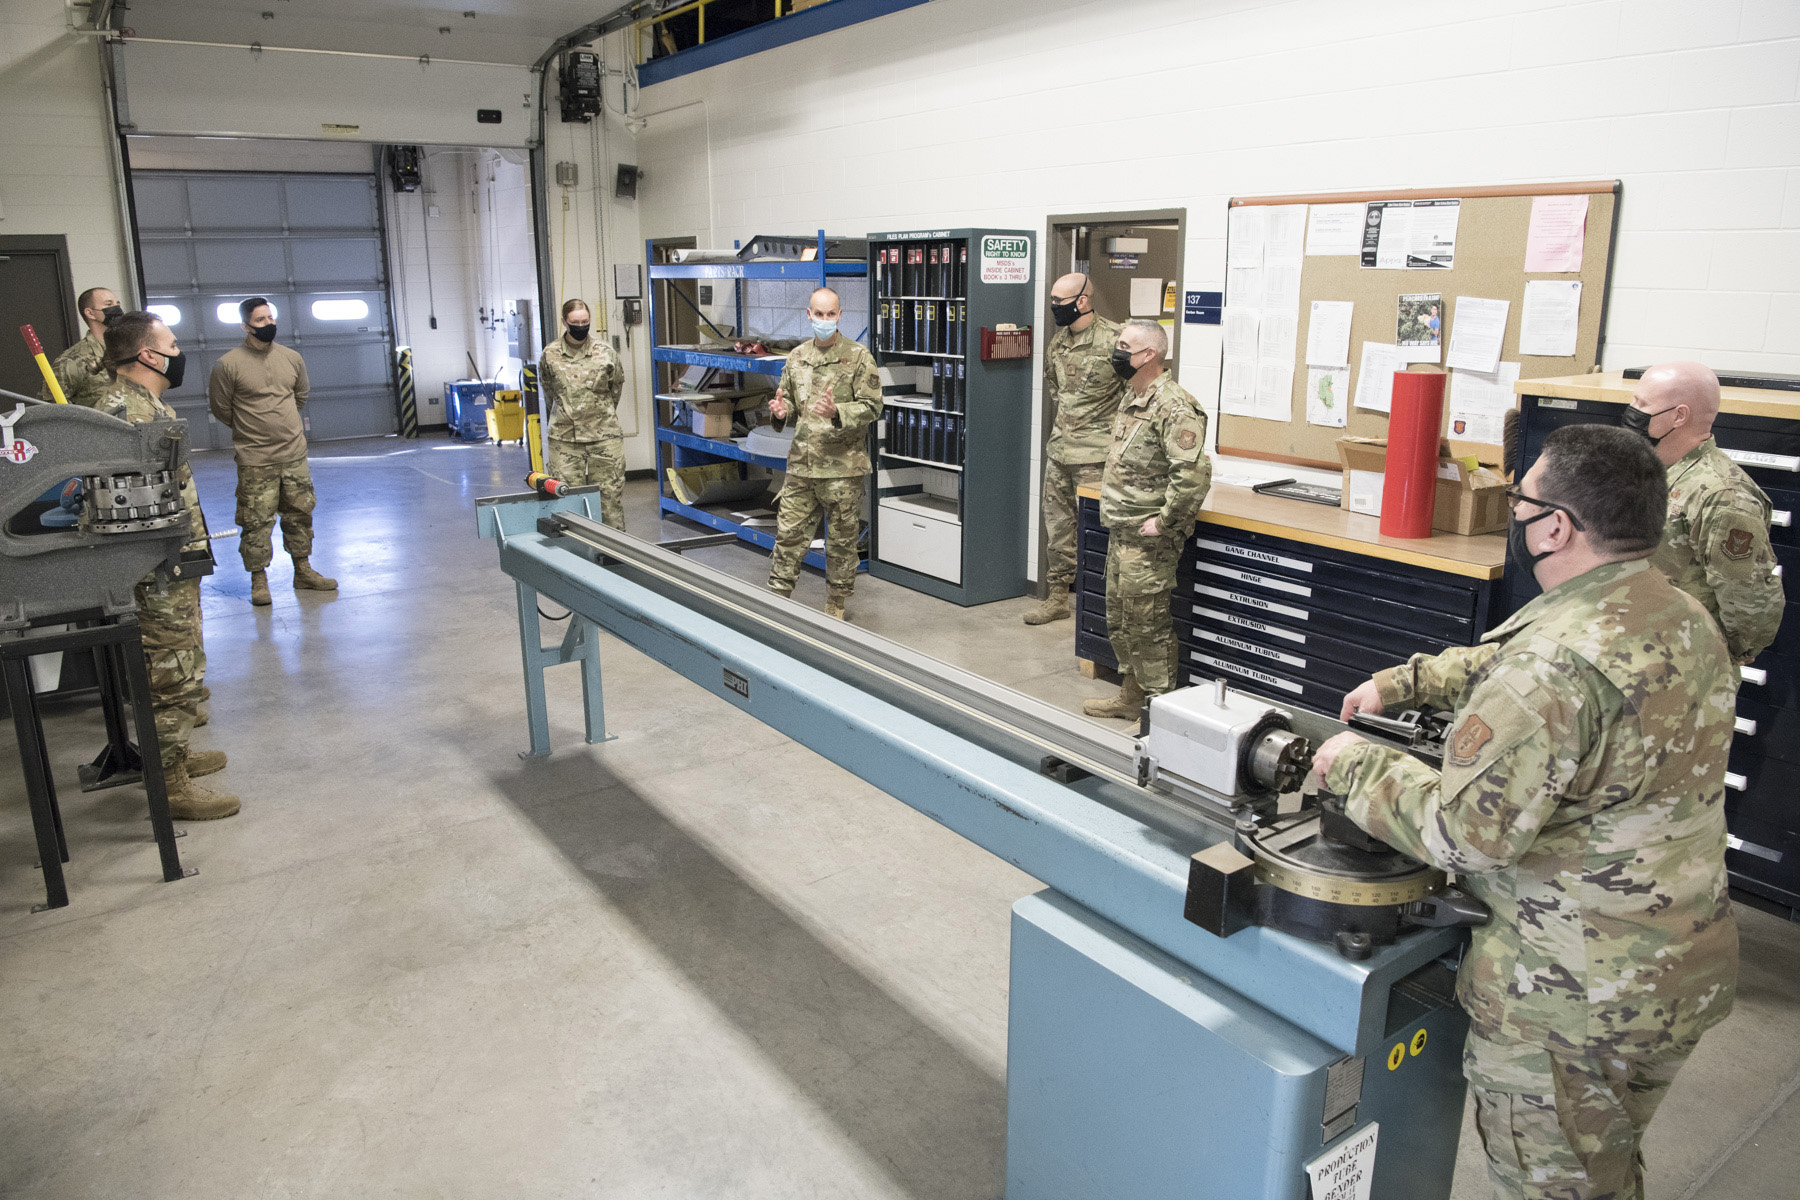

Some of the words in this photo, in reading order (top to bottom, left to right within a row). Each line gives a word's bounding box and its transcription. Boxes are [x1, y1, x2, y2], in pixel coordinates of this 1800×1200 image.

[987, 240, 1024, 250] SAFETY
[705, 266, 725, 278] PARTS
[727, 265, 745, 278] RACK
[1187, 295, 1200, 304] 137
[1225, 546, 1245, 555] GANG
[1247, 550, 1280, 563] CHANNEL
[1240, 573, 1262, 583] HINGE
[1230, 594, 1268, 608] EXTRUSION
[1228, 615, 1266, 630] EXTRUSION
[1216, 636, 1252, 650] ALUMINUM
[1254, 647, 1280, 659] TUBING
[1213, 659, 1249, 675] ALUMINUM
[1252, 671, 1278, 684] TUBING
[732, 676, 748, 695] PHI
[1318, 1133, 1375, 1181] PRODUCTION
[1333, 1160, 1357, 1184] TUBE
[1324, 1170, 1362, 1200] BENDER
